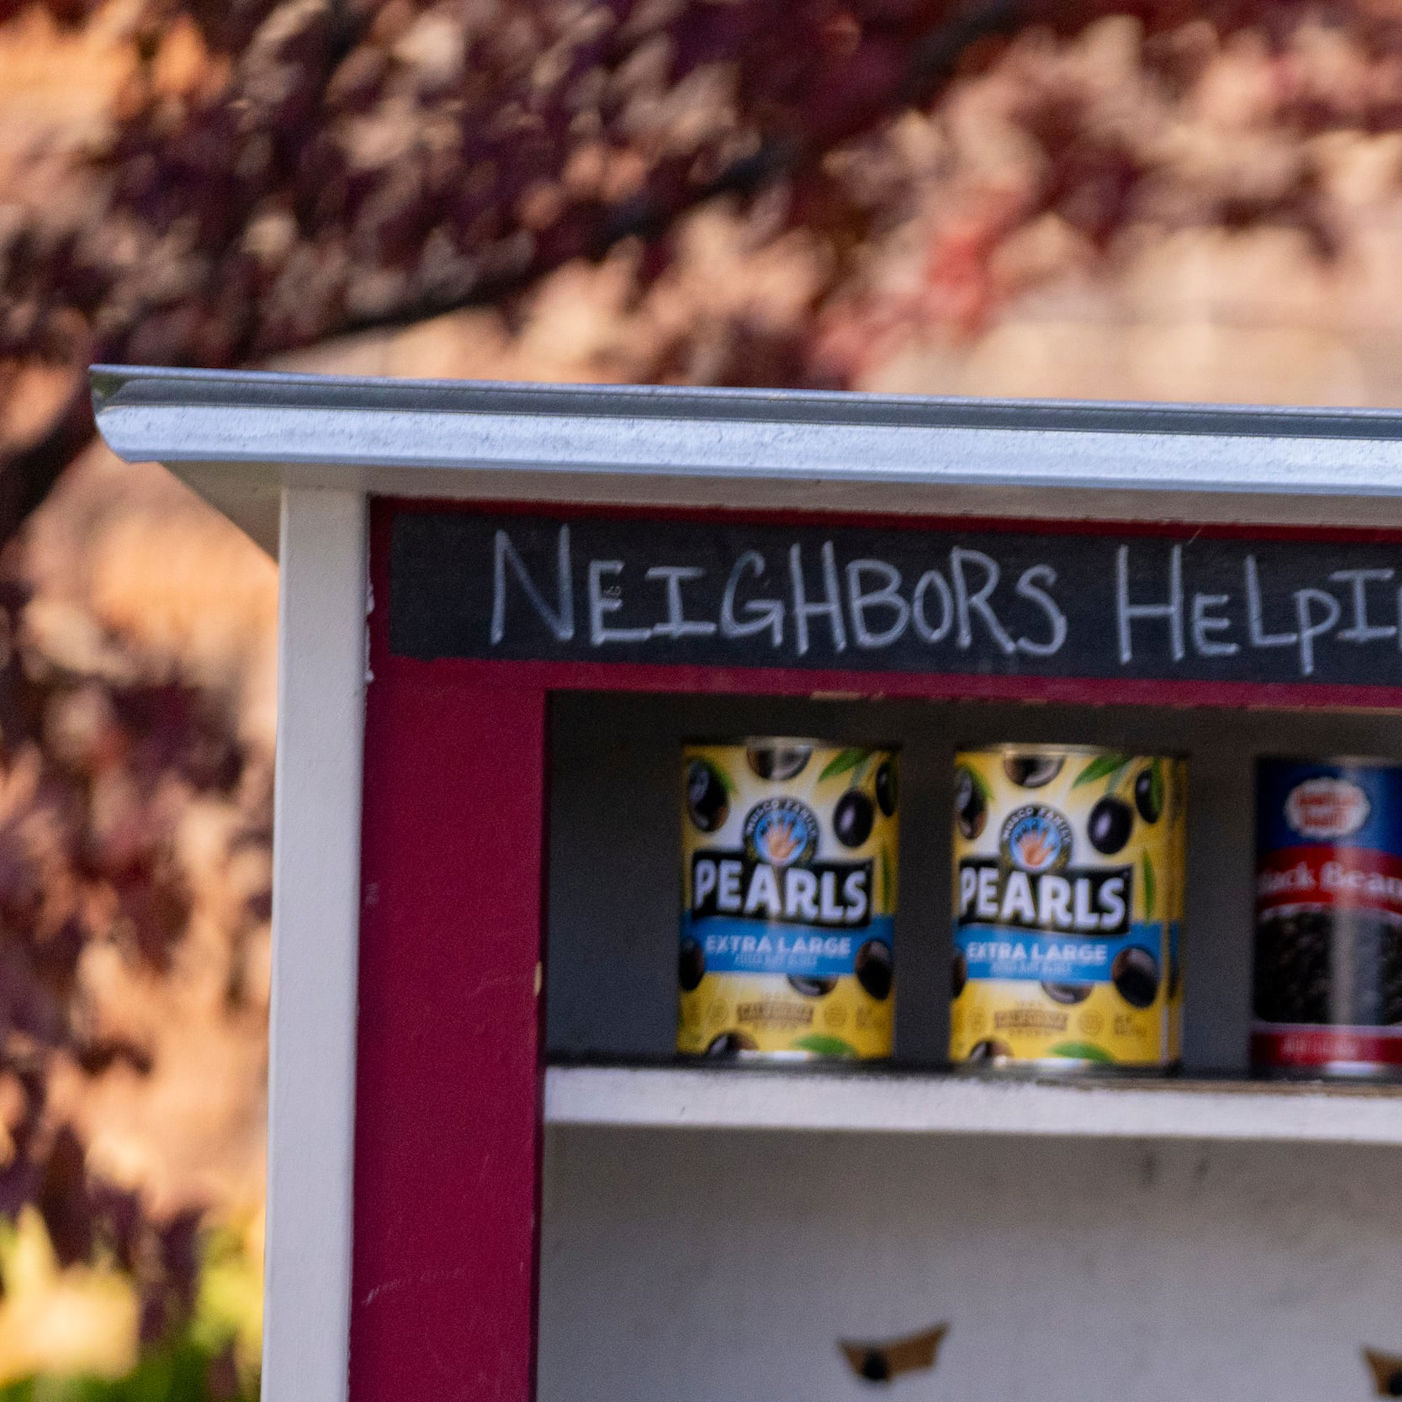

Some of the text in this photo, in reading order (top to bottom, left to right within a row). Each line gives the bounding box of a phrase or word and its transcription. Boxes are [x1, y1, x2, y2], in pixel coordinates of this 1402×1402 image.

[491, 524, 1067, 657] NEIGHBORS
[695, 858, 868, 923] PEARLS
[960, 866, 1126, 930] PEARLS
[705, 934, 852, 959] EXTRA LARGE
[966, 941, 1108, 966] EXTRA LARGE
